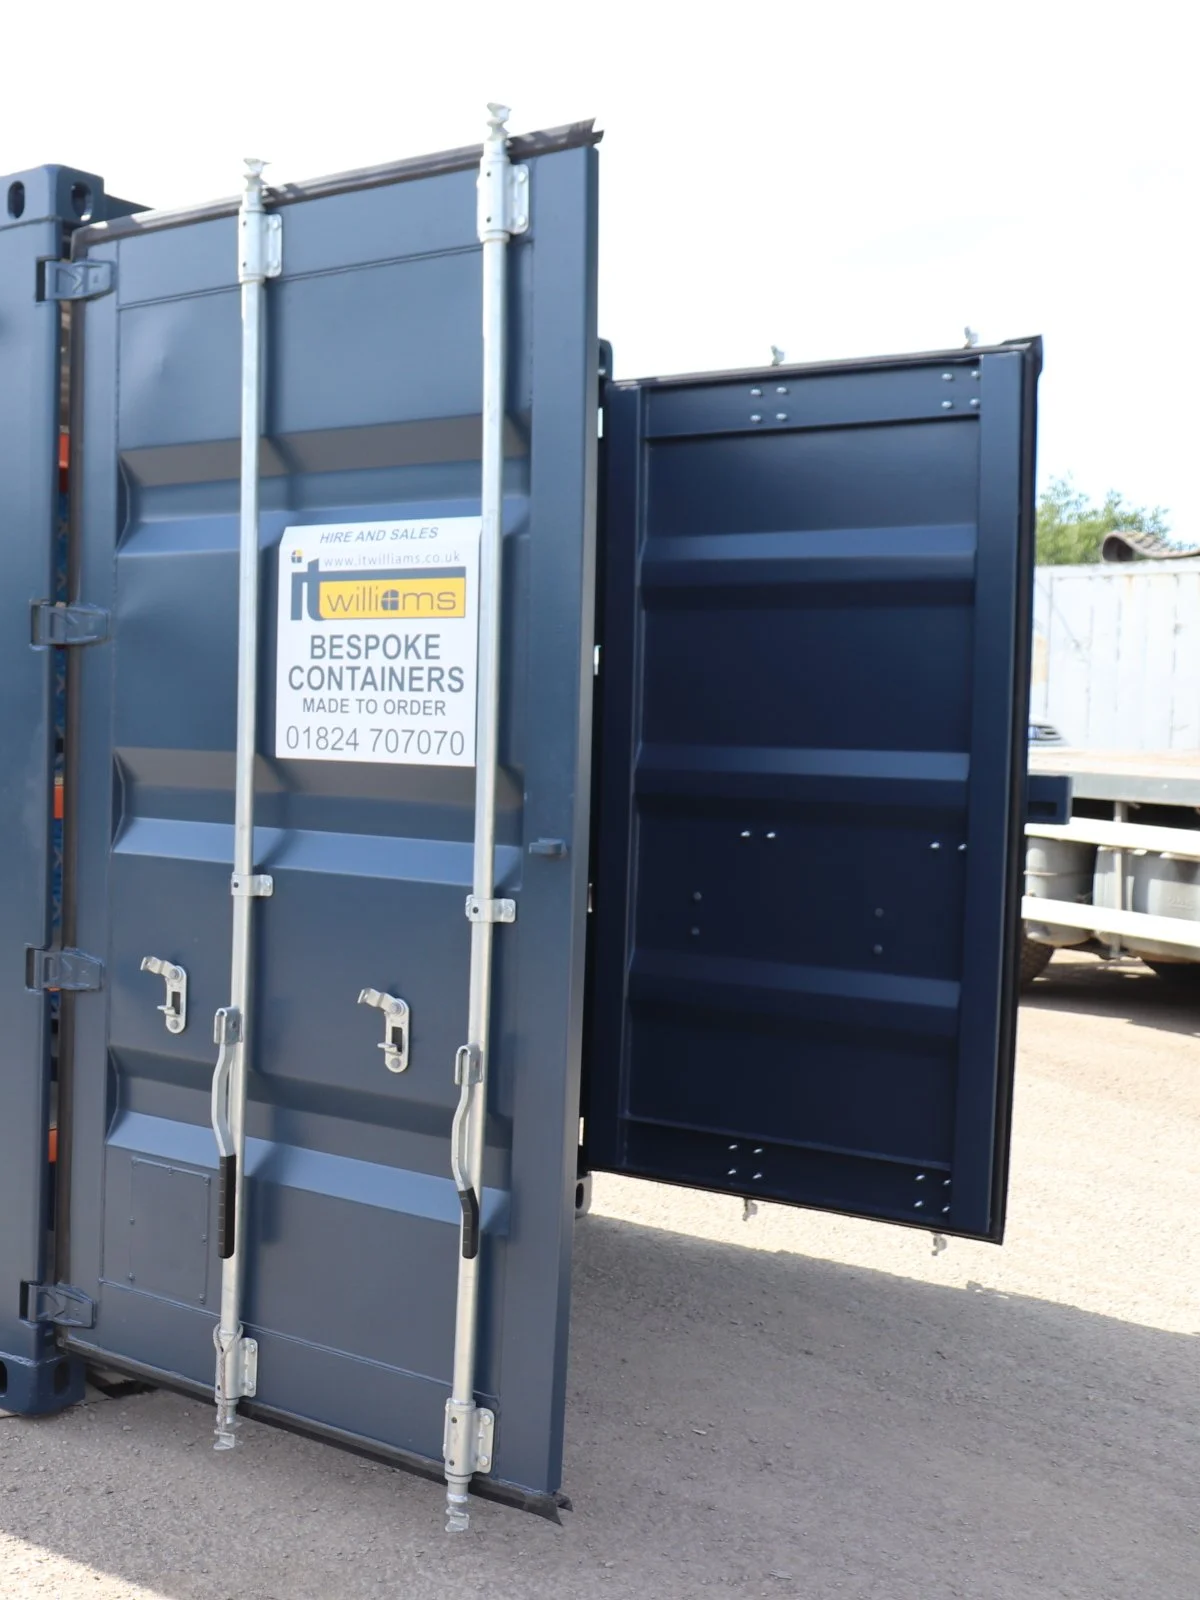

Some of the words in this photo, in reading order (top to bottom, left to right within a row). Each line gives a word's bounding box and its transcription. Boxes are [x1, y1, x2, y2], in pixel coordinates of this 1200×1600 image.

[320, 530, 353, 544] HIRE
[355, 529, 386, 542] AND
[390, 527, 439, 541] SALES
[324, 551, 461, 567] www.itwilliams.co.uk
[327, 586, 456, 613] williams
[310, 634, 441, 660] BESPOKE
[288, 665, 465, 693] CONTAINERS
[302, 698, 350, 714] MADE
[355, 698, 378, 715] TO
[383, 699, 446, 716] ORDER
[286, 725, 360, 751] 01824
[369, 728, 465, 756] 707070
